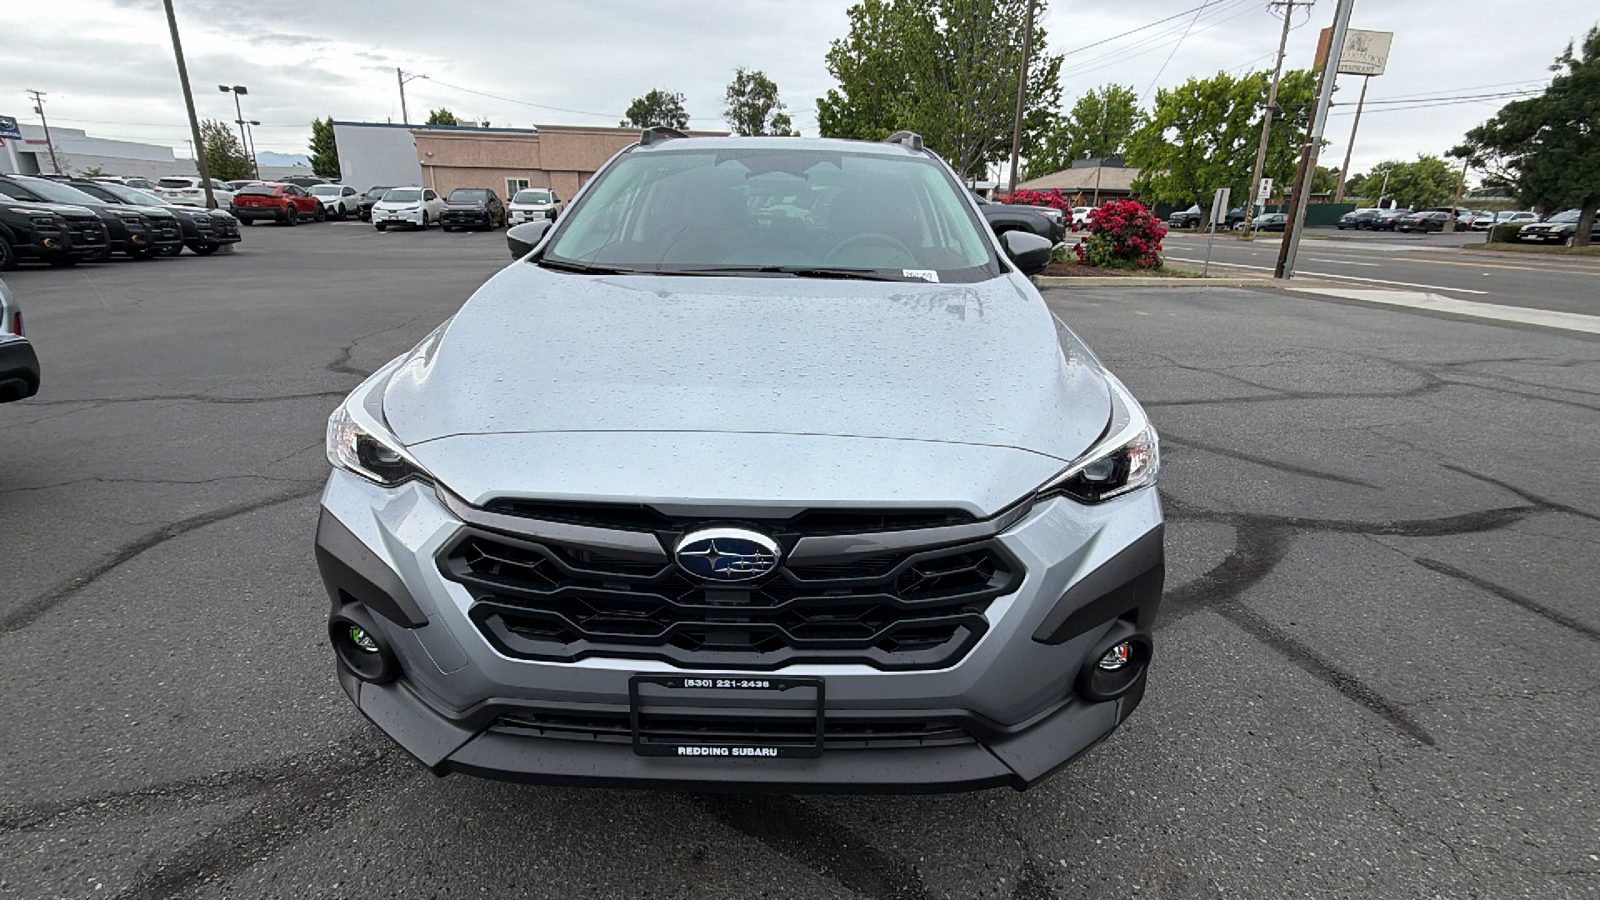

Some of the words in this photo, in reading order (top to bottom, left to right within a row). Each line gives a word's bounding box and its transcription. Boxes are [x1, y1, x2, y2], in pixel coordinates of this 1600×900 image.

[684, 679, 713, 688] (530)
[677, 746, 729, 756] REDDING
[731, 747, 778, 757] SUBARU
